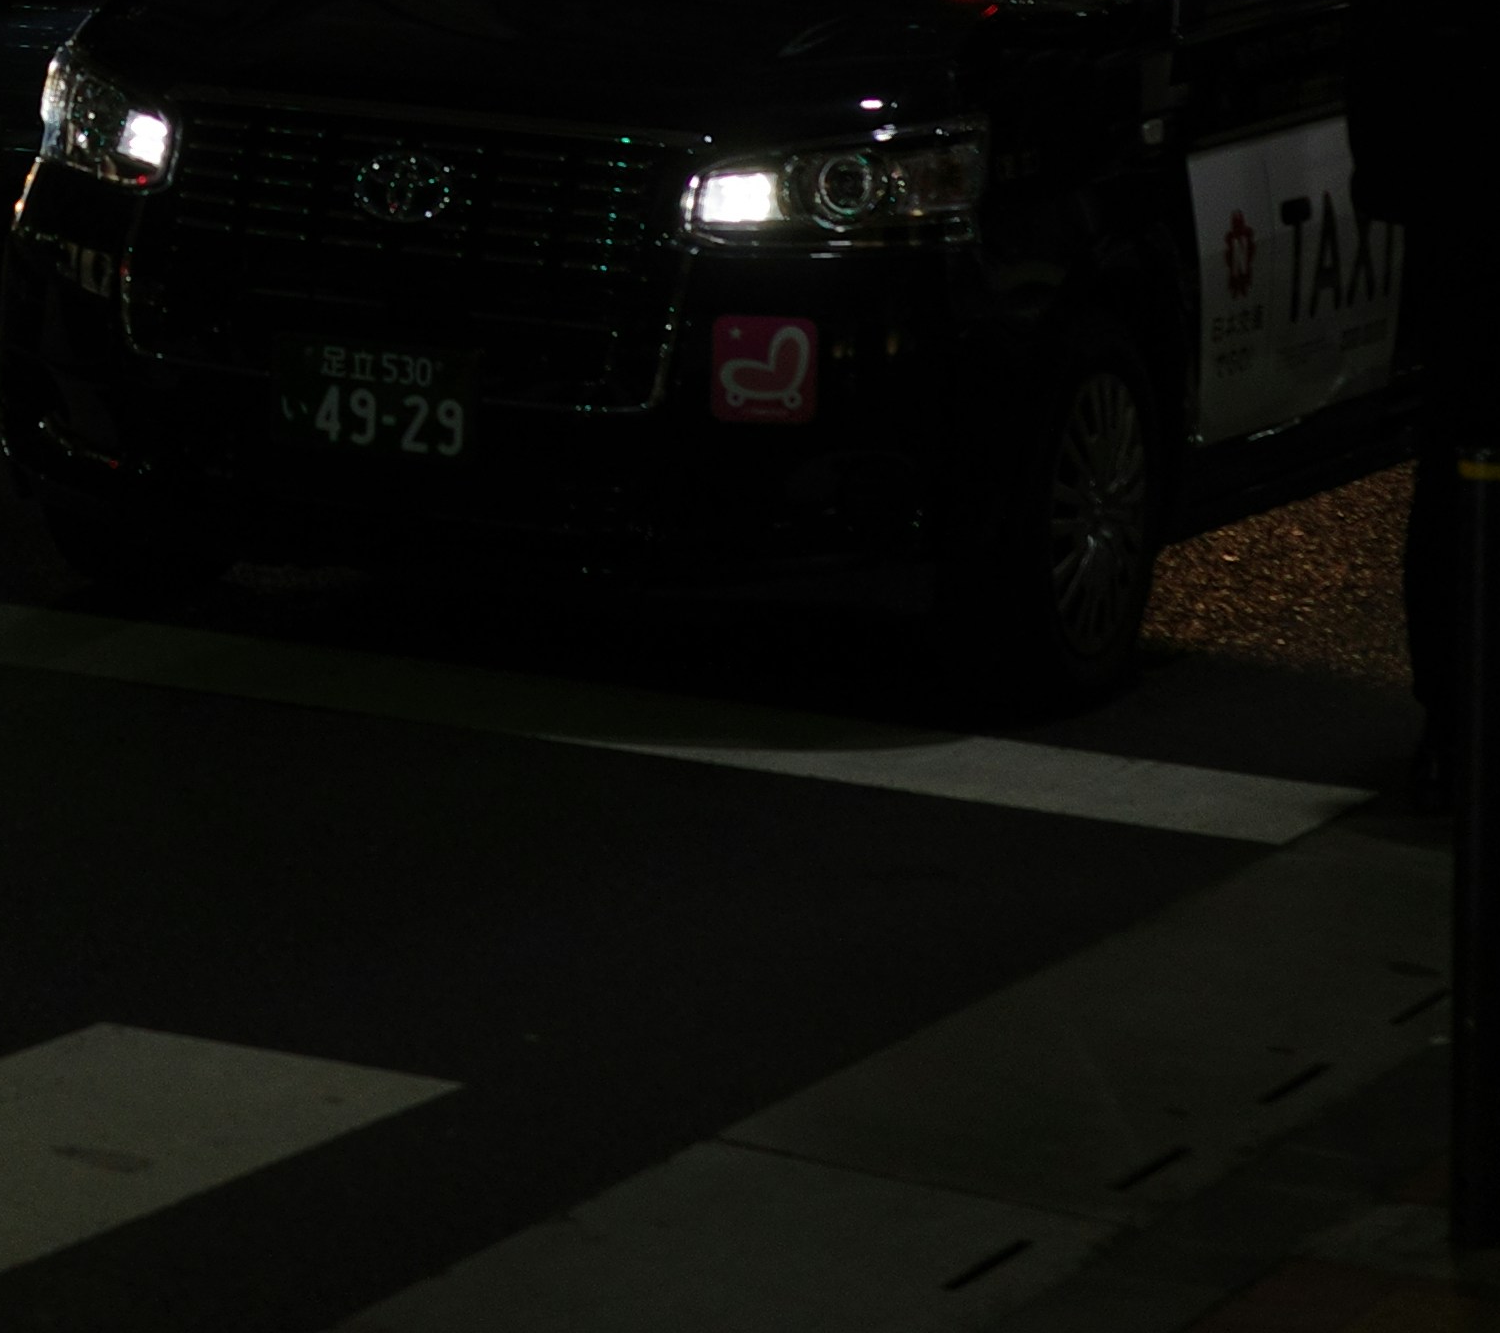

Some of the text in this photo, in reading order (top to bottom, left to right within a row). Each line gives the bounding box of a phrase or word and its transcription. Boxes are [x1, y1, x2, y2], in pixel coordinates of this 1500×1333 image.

[1281, 190, 1395, 323] TAXI
[320, 345, 433, 389] 足立 530
[314, 383, 466, 458] 49-29
